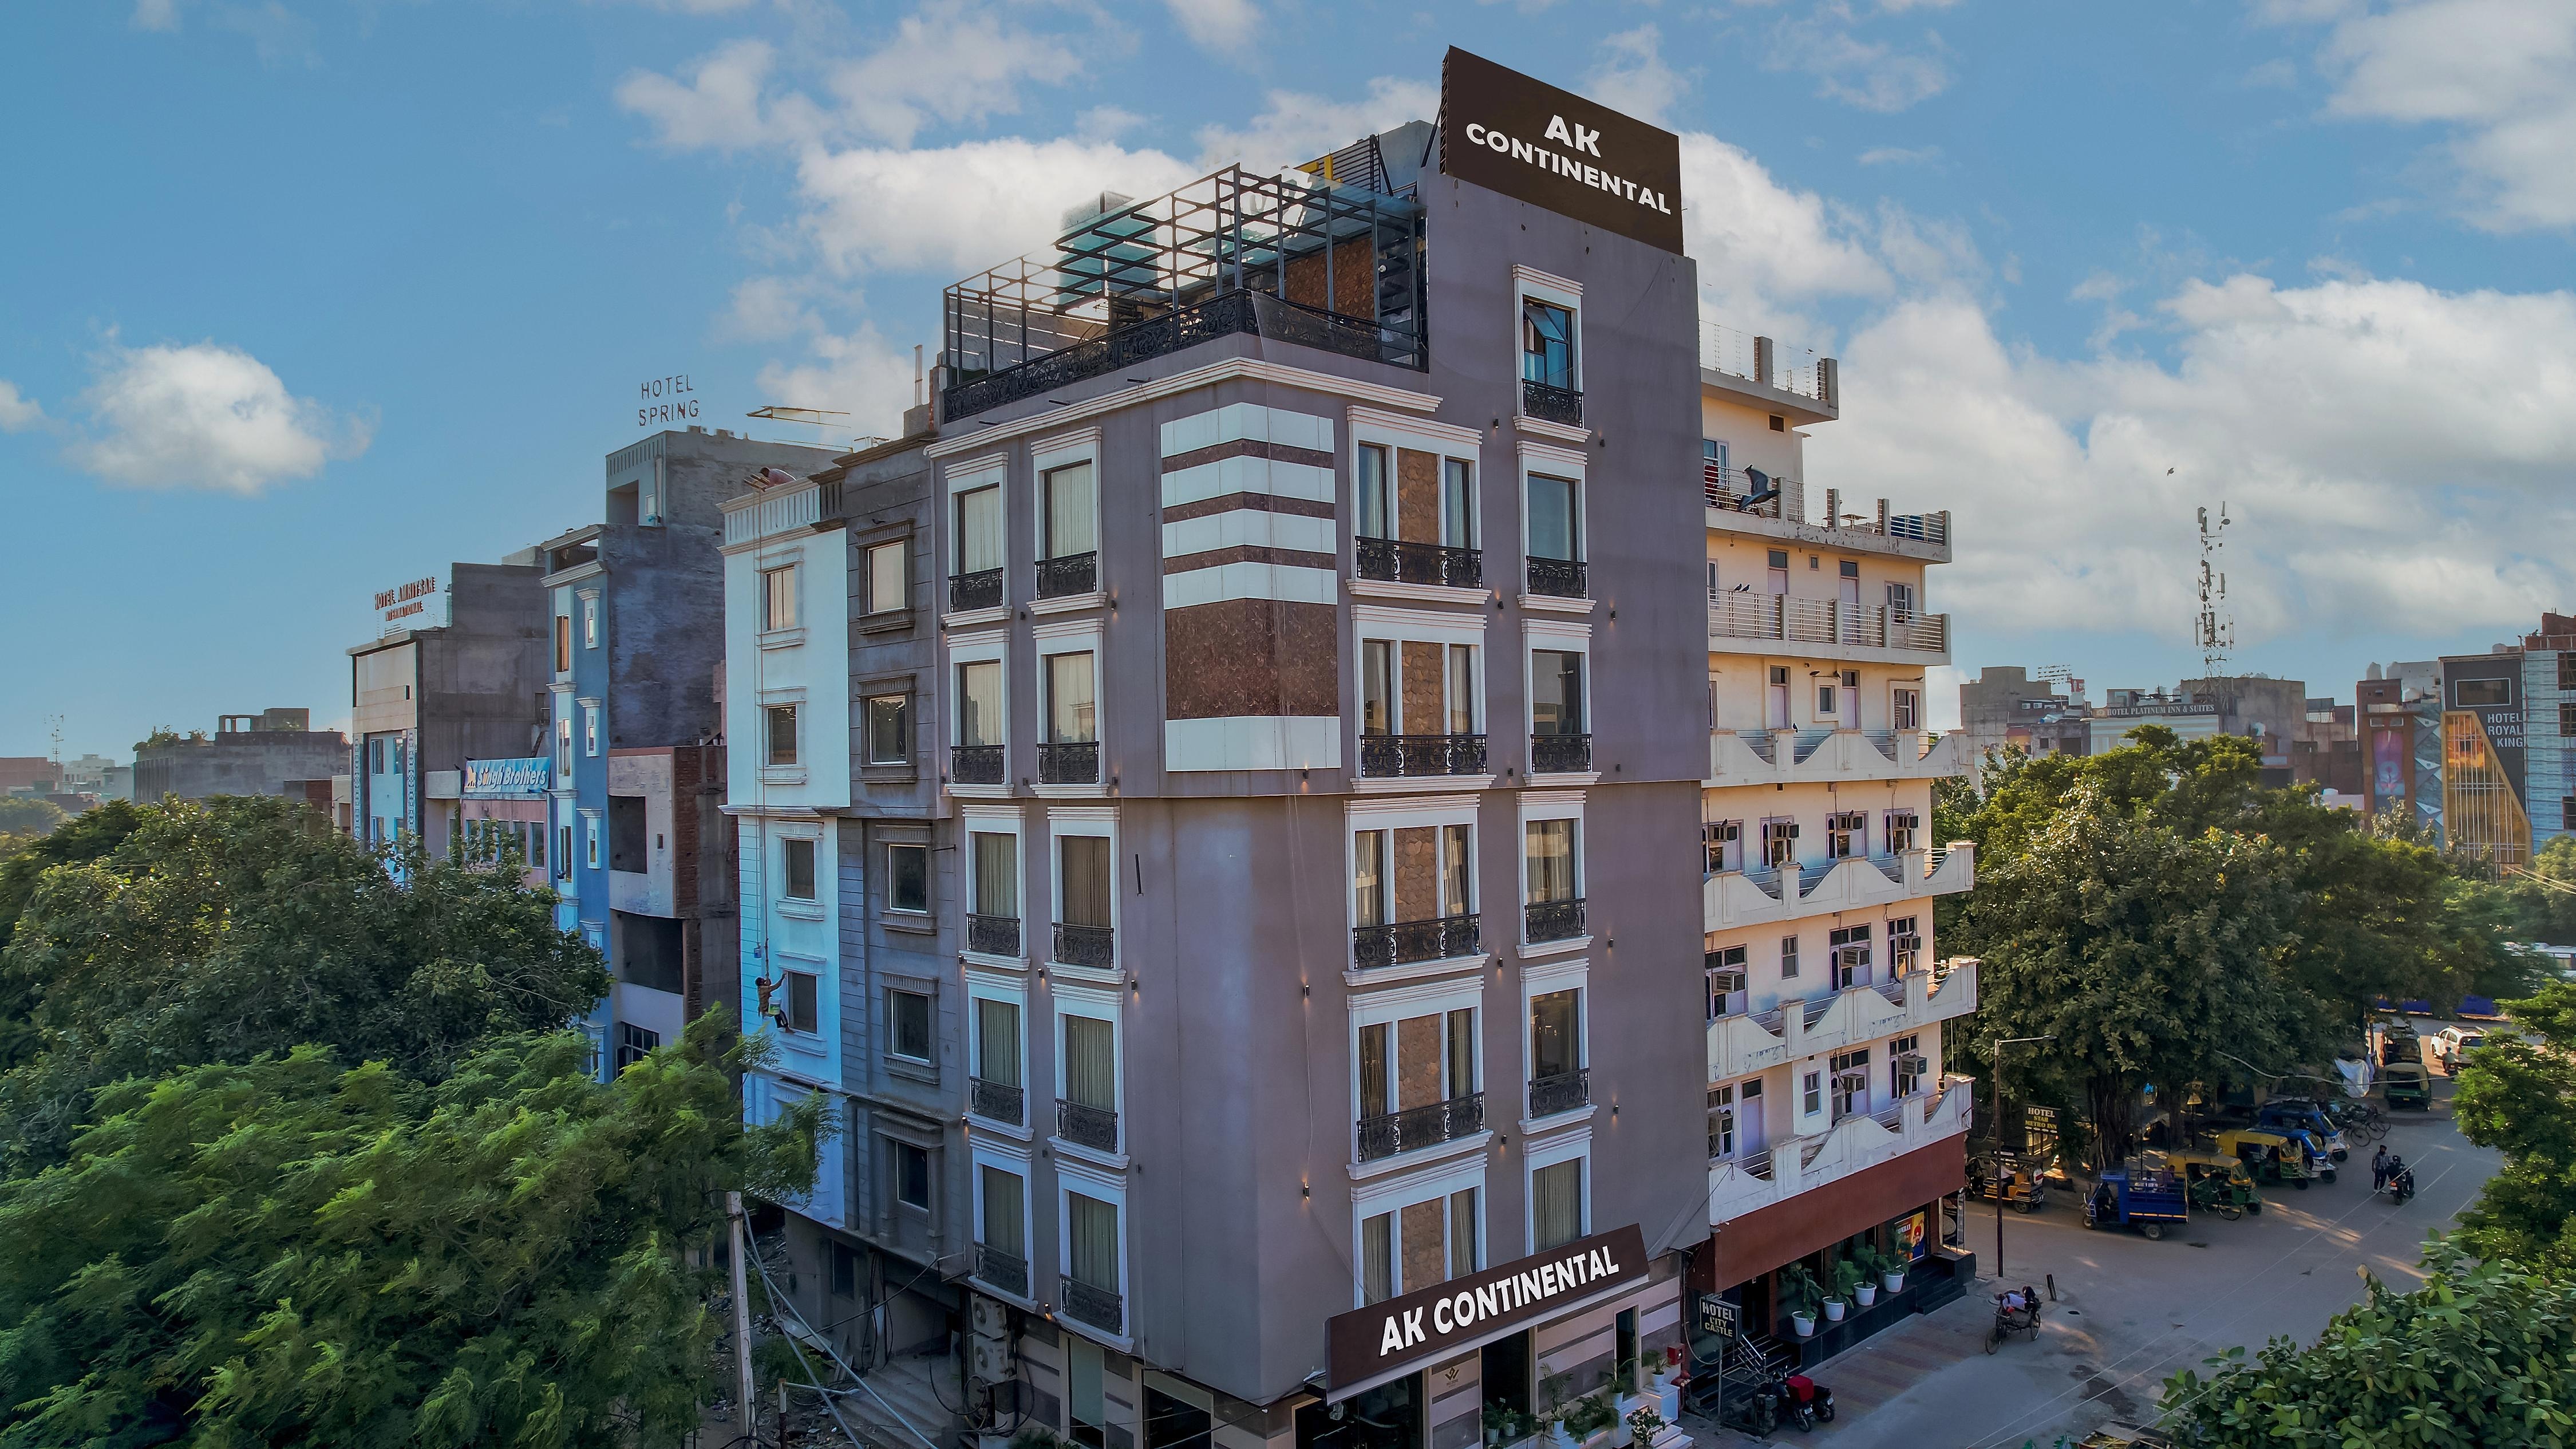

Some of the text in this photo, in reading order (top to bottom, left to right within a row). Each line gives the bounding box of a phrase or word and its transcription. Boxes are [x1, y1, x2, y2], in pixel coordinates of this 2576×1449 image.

[1544, 115, 1601, 158] AK
[1466, 123, 1672, 215] CONTINENTAL
[641, 374, 694, 400] HOTEL
[639, 400, 700, 427] SPRING
[2131, 705, 2166, 715] PLATINUM
[2167, 704, 2181, 713] INN
[2182, 704, 2188, 713] &
[2189, 704, 2215, 712] SUITES
[2487, 713, 2523, 724] HOTEL
[2487, 725, 2523, 736] ROYAL
[2496, 737, 2523, 747] KING
[477, 765, 547, 789] Singh Brothers
[2028, 1107, 2055, 1118] HOTEL
[1380, 1245, 1619, 1357] AK CONTINENTAL
[1702, 1302, 1735, 1321] HOTEL
[1705, 1322, 1733, 1337] CASTLE
[1710, 1317, 1727, 1328] CITY
